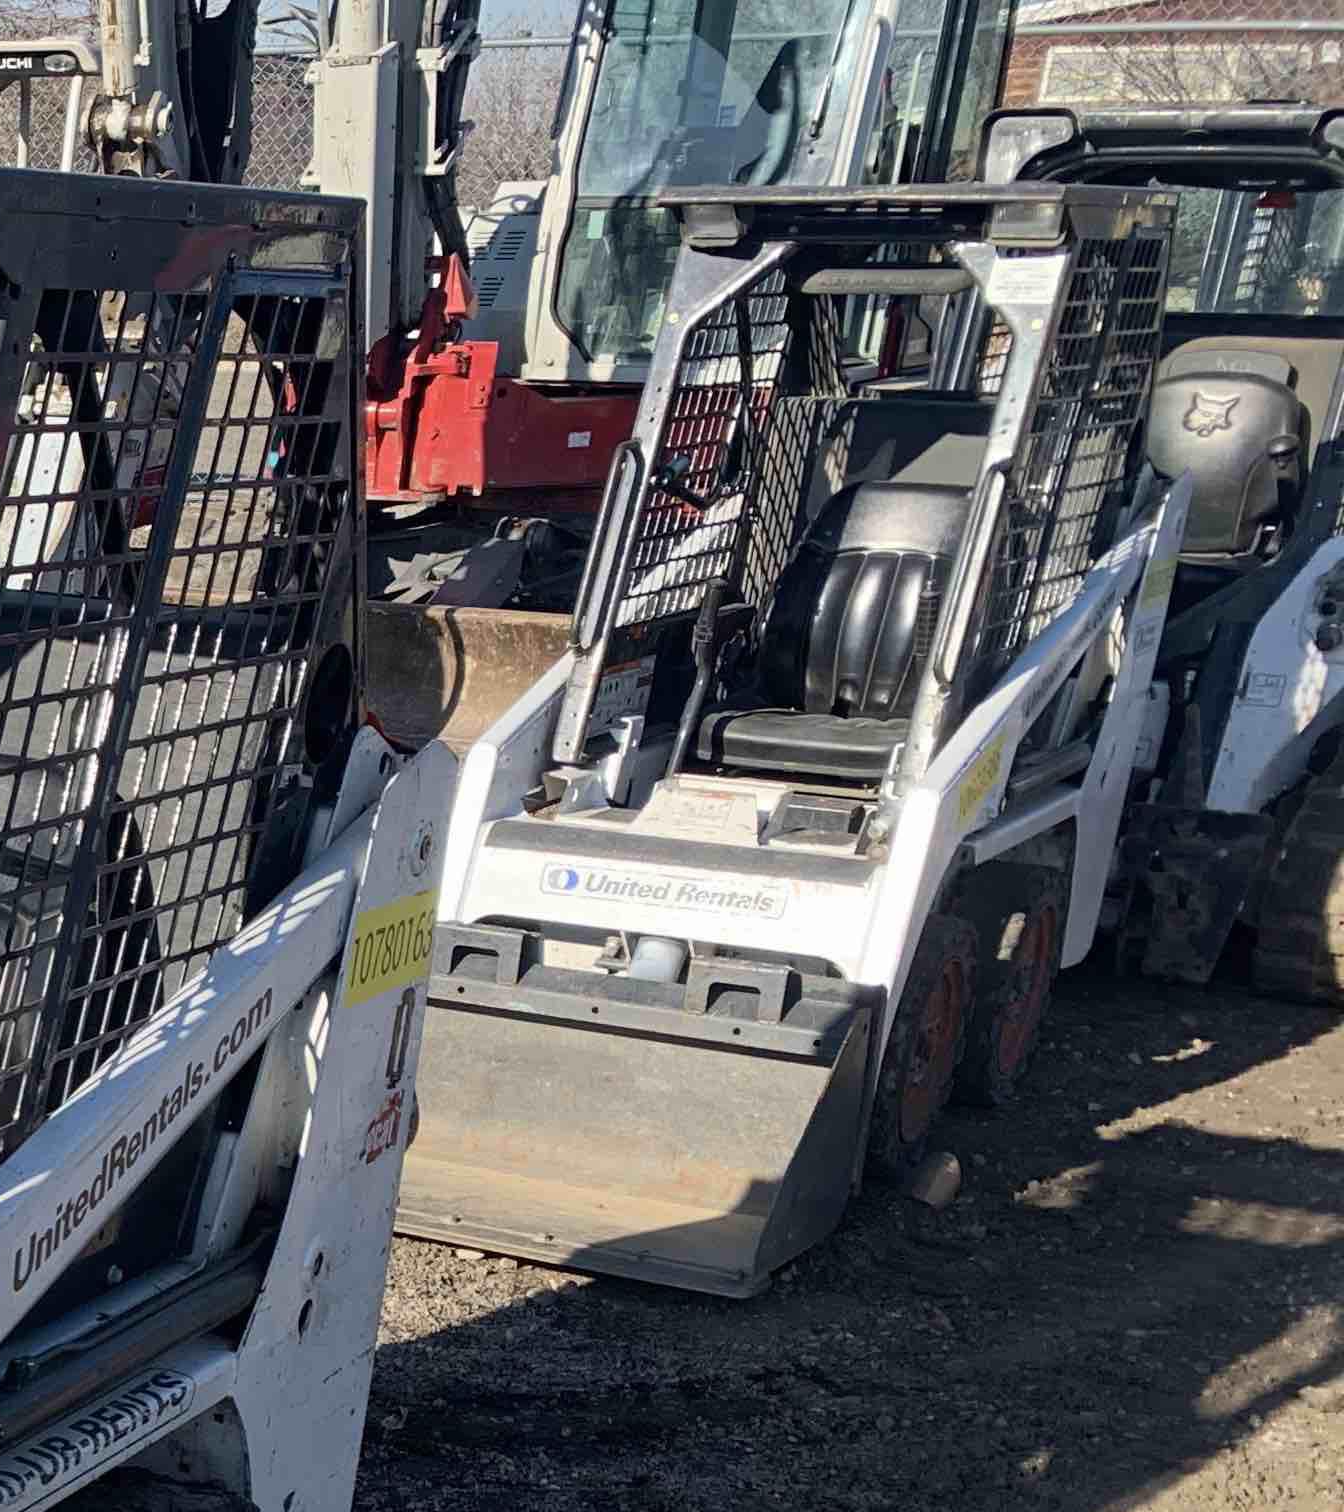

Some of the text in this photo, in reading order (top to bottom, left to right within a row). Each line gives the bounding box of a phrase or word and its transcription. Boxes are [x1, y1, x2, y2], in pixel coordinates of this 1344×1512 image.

[585, 872, 775, 912] United Rentals
[350, 910, 434, 987] 10780163
[13, 987, 273, 1292] UnitedRentals.com
